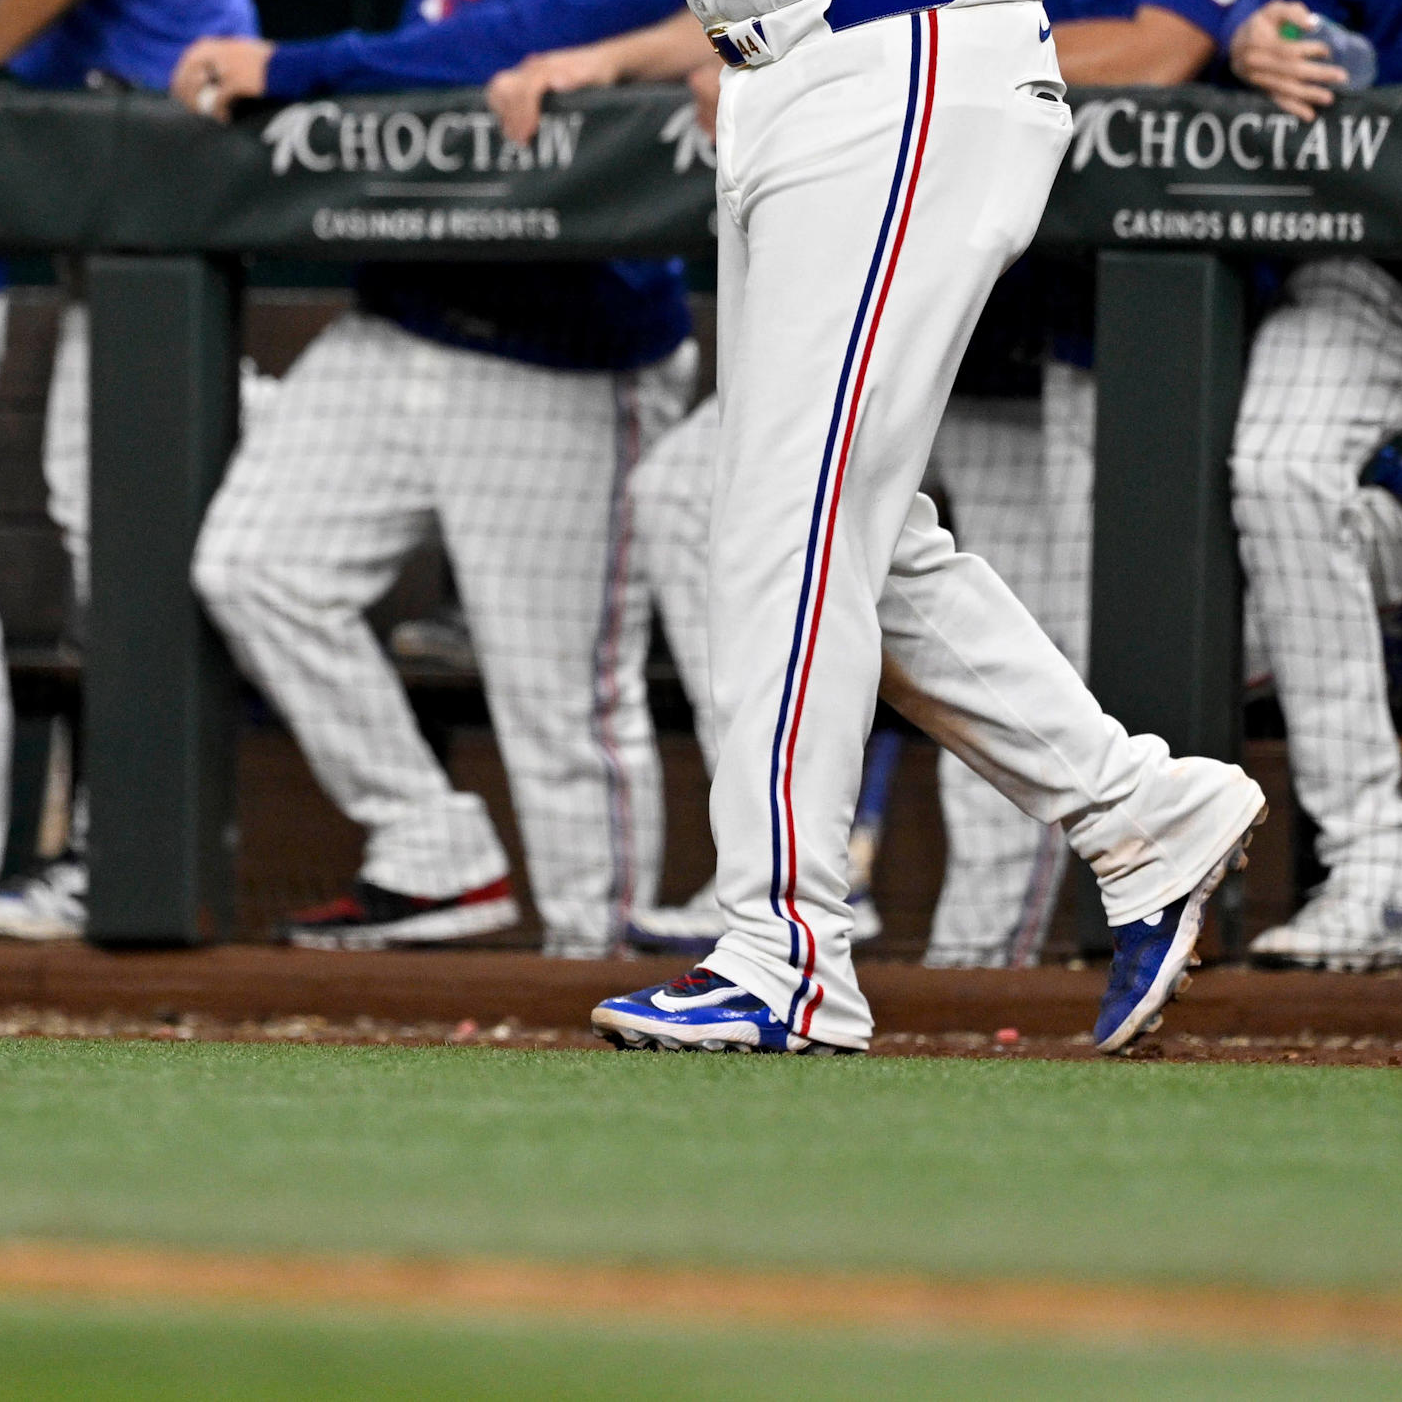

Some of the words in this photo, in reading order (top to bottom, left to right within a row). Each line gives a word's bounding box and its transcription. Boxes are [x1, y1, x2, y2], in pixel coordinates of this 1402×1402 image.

[736, 35, 761, 59] 44
[1095, 100, 1391, 171] CHOCTAW
[1113, 209, 1223, 241] CASINOS
[1229, 212, 1247, 240] &
[1251, 211, 1364, 243] RESORTS
